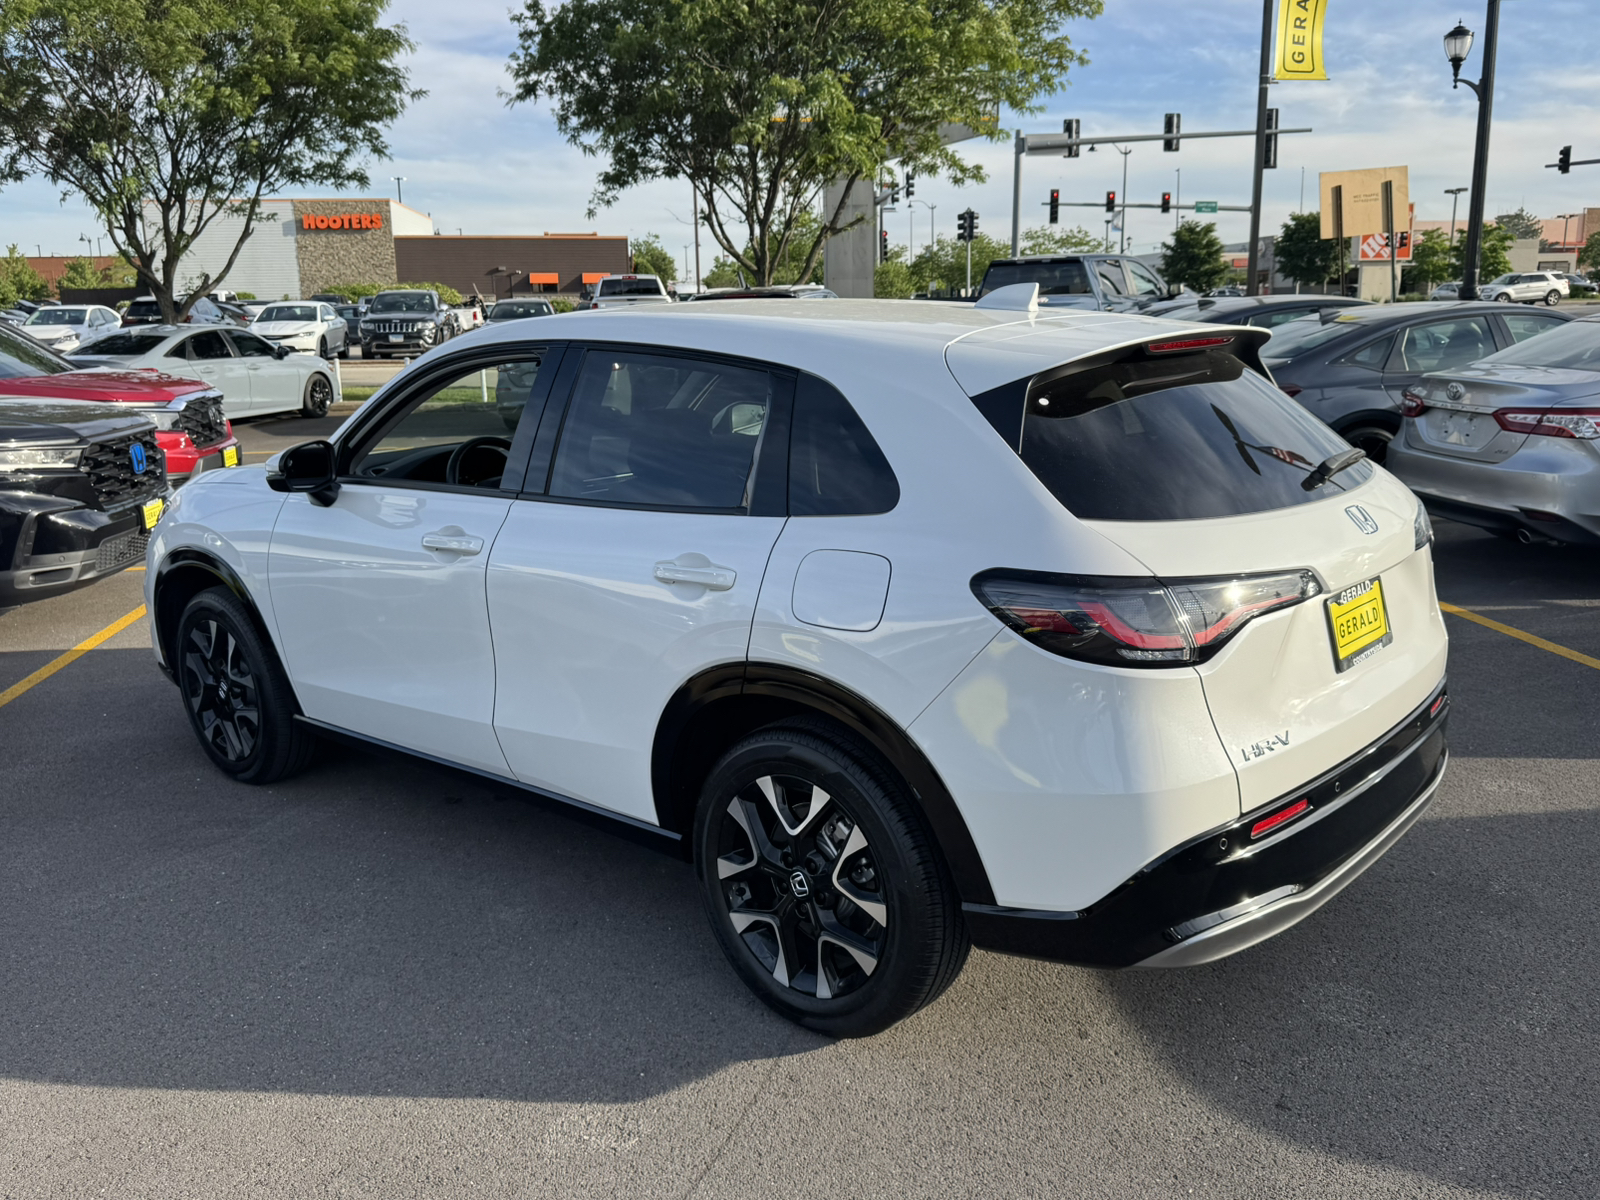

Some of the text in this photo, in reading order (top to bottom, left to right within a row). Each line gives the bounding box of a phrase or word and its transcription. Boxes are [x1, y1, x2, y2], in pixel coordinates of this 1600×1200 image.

[1291, 0, 1310, 64] GERA
[302, 213, 383, 230] HOOTERS
[1341, 580, 1371, 603] GERALD
[1339, 606, 1379, 639] GERALD
[1241, 730, 1290, 761] HR-V
